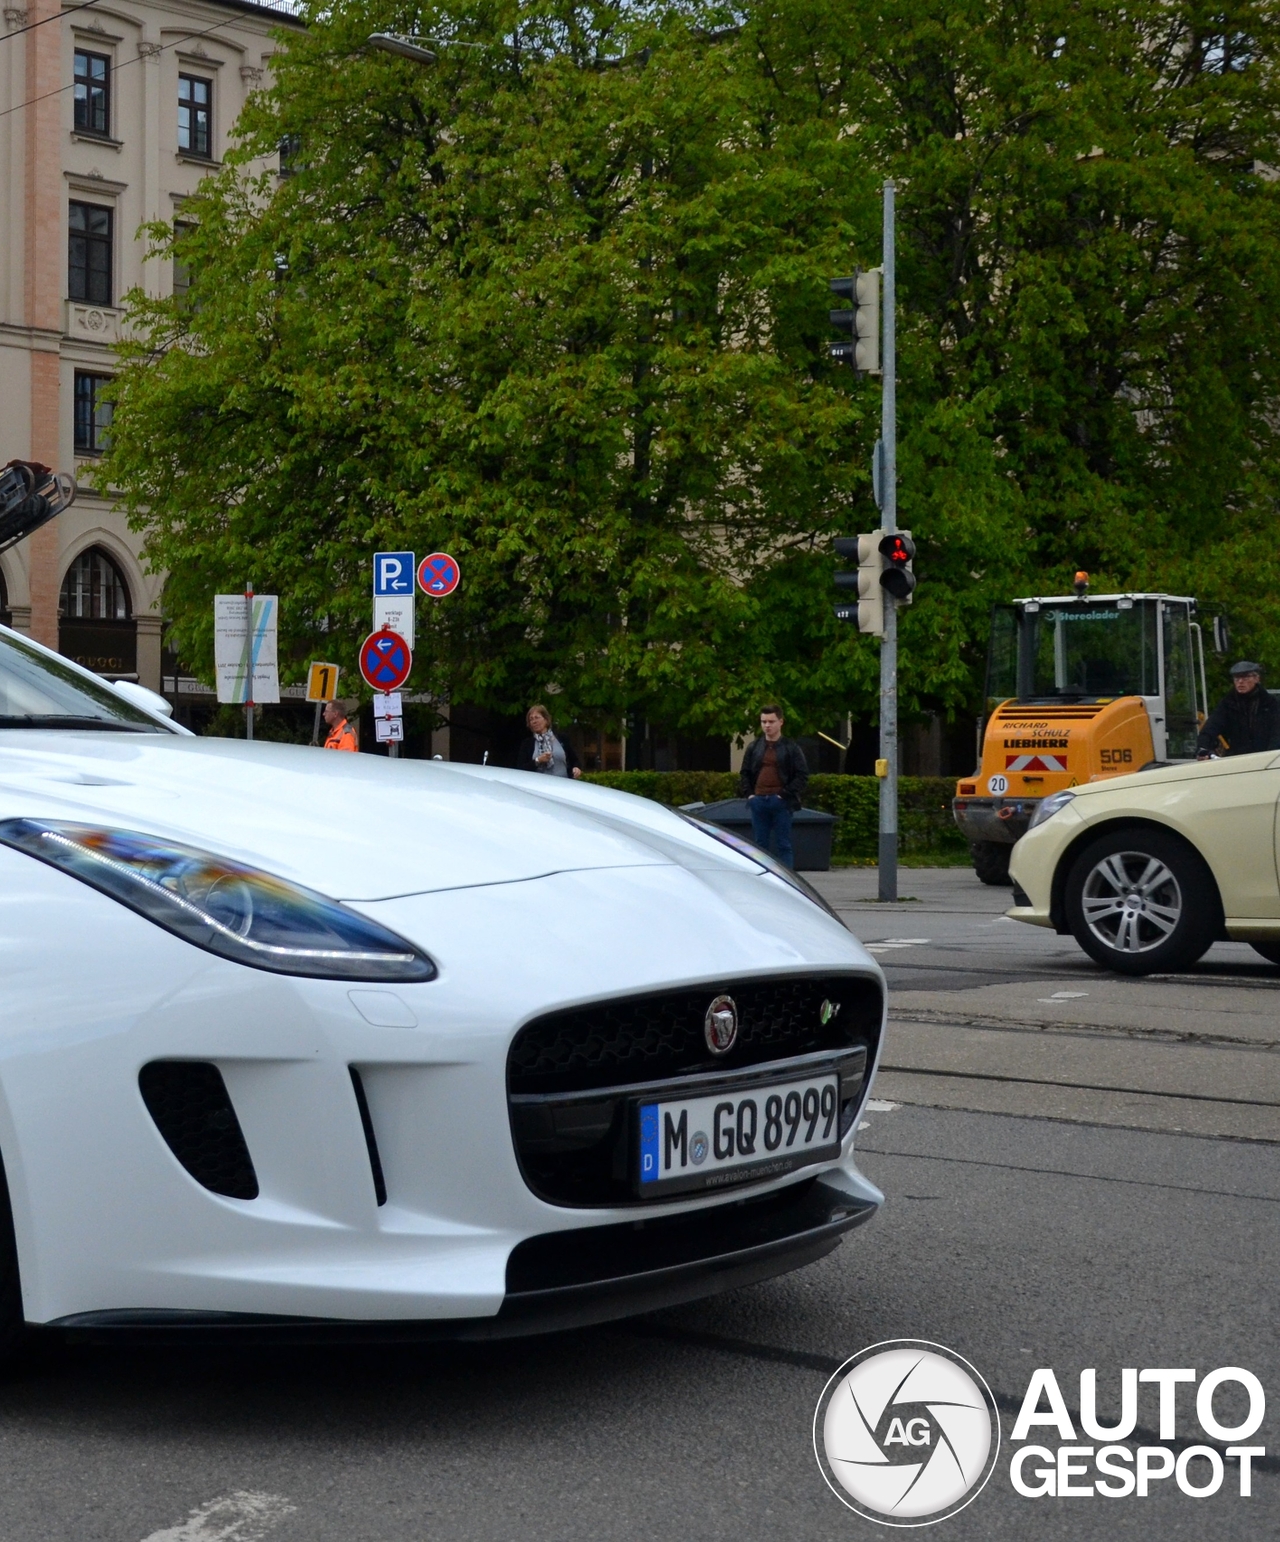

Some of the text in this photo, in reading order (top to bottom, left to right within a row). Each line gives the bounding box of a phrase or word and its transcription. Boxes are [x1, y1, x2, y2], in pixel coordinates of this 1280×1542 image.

[380, 558, 402, 591] P
[1059, 610, 1120, 620] Stereolader
[319, 667, 329, 699] 1
[1031, 729, 1071, 737] SCHULZ
[1003, 738, 1069, 748] LIEBHERR
[1100, 748, 1133, 764] 506
[991, 777, 1005, 791] 20
[664, 1084, 837, 1170] M GQ 8999
[643, 1153, 653, 1171] D
[705, 1160, 793, 1186] www.avalon-muenchen.de
